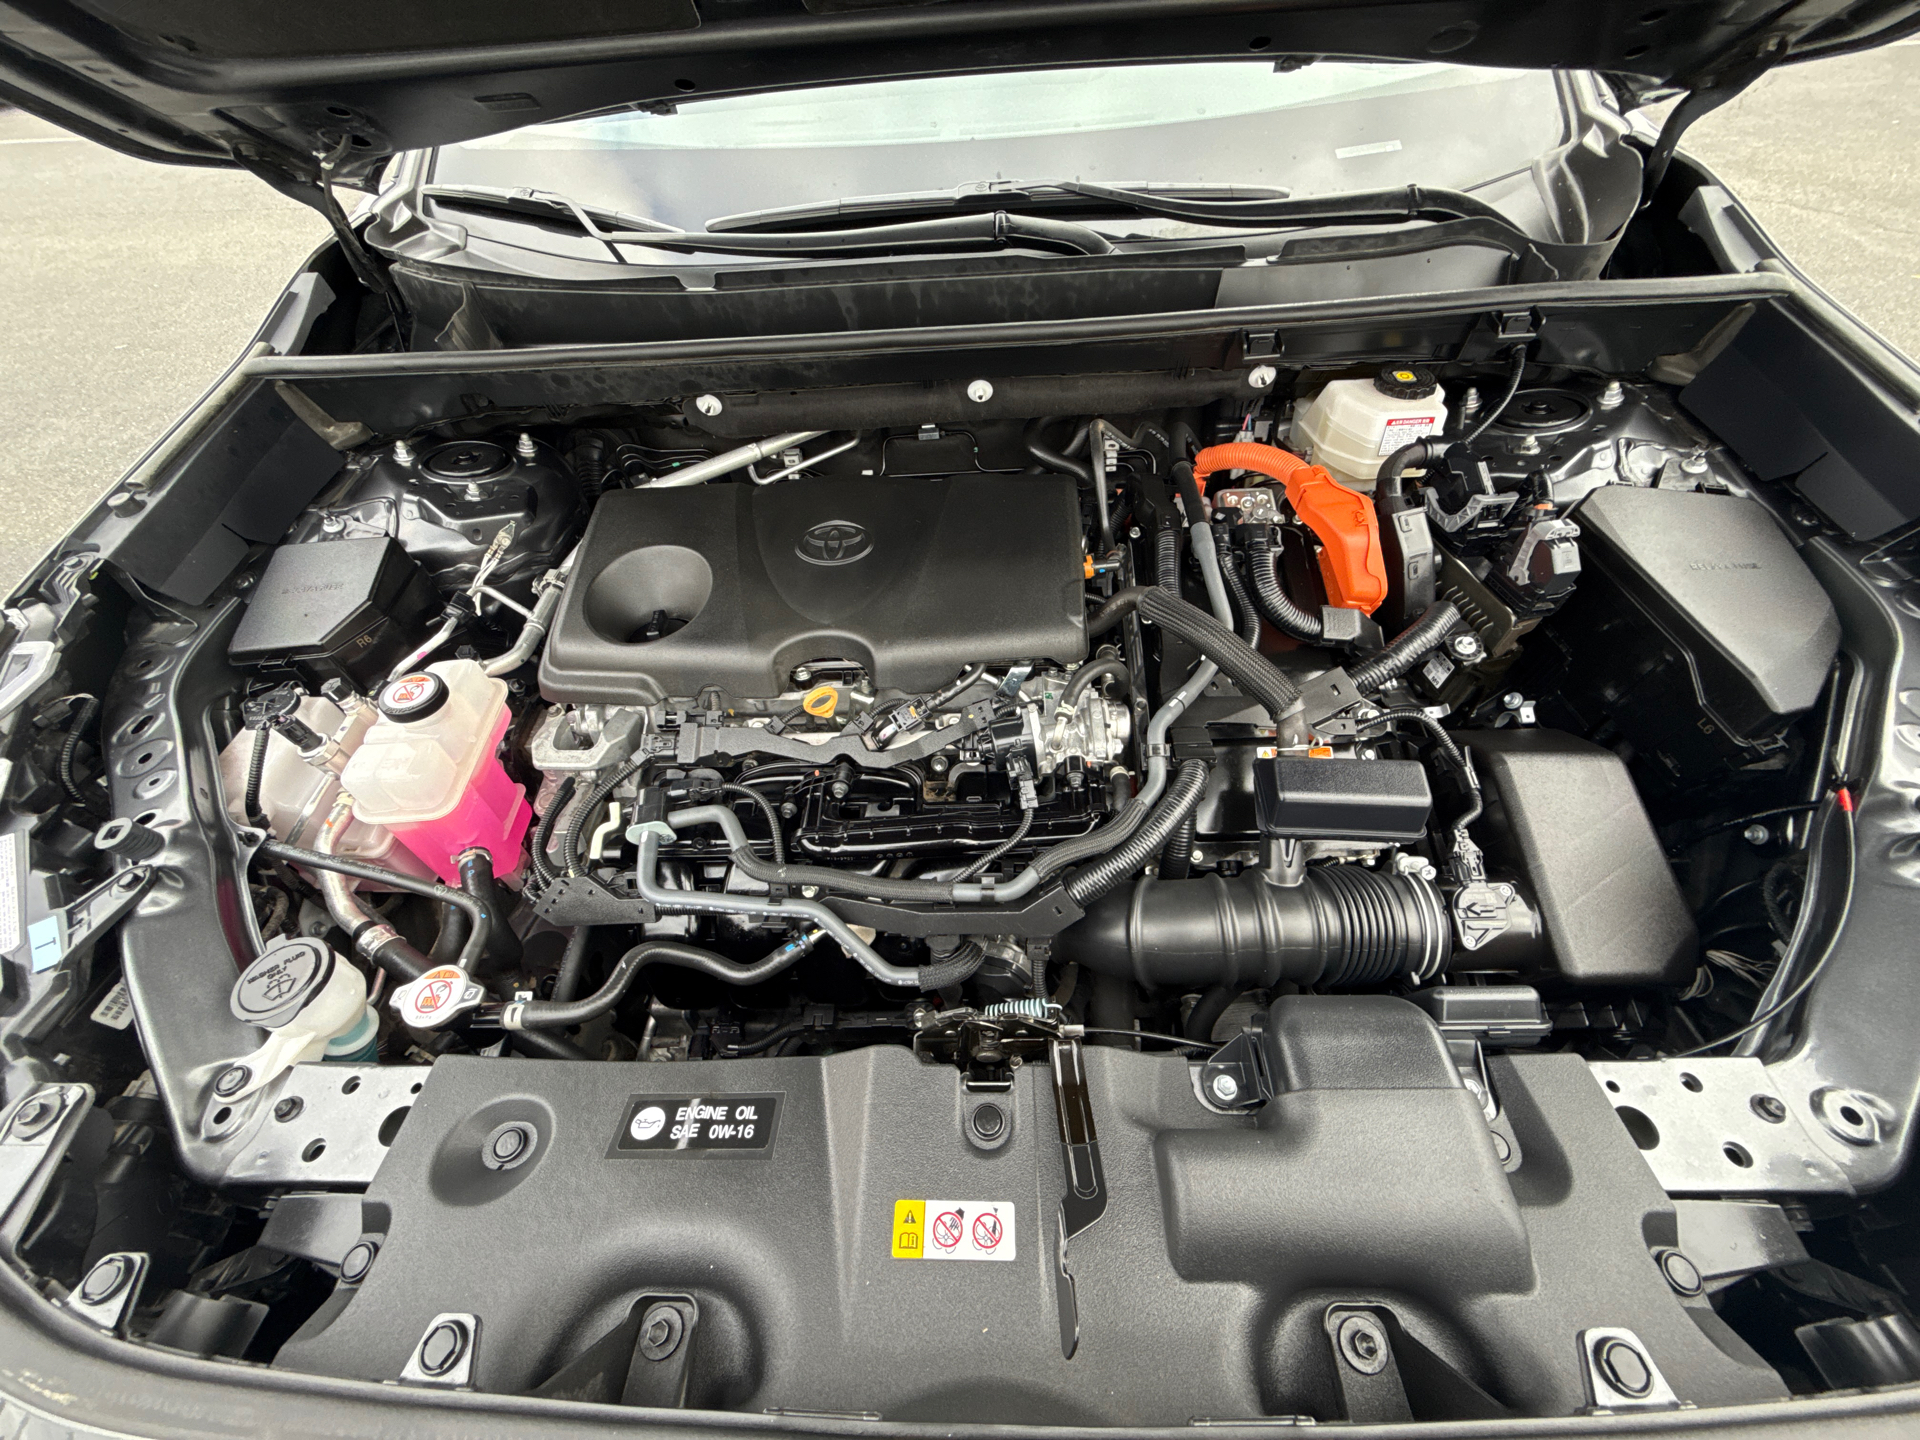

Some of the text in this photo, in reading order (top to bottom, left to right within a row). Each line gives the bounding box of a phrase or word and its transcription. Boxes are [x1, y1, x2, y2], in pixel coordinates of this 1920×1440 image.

[356, 635, 372, 648] R6
[1697, 717, 1715, 735] L6
[247, 951, 306, 985] WASHER FLUID
[267, 965, 288, 980] ONLY
[675, 1105, 758, 1121] ENGINE OIL
[669, 1123, 755, 1140] SAE 0W-16
